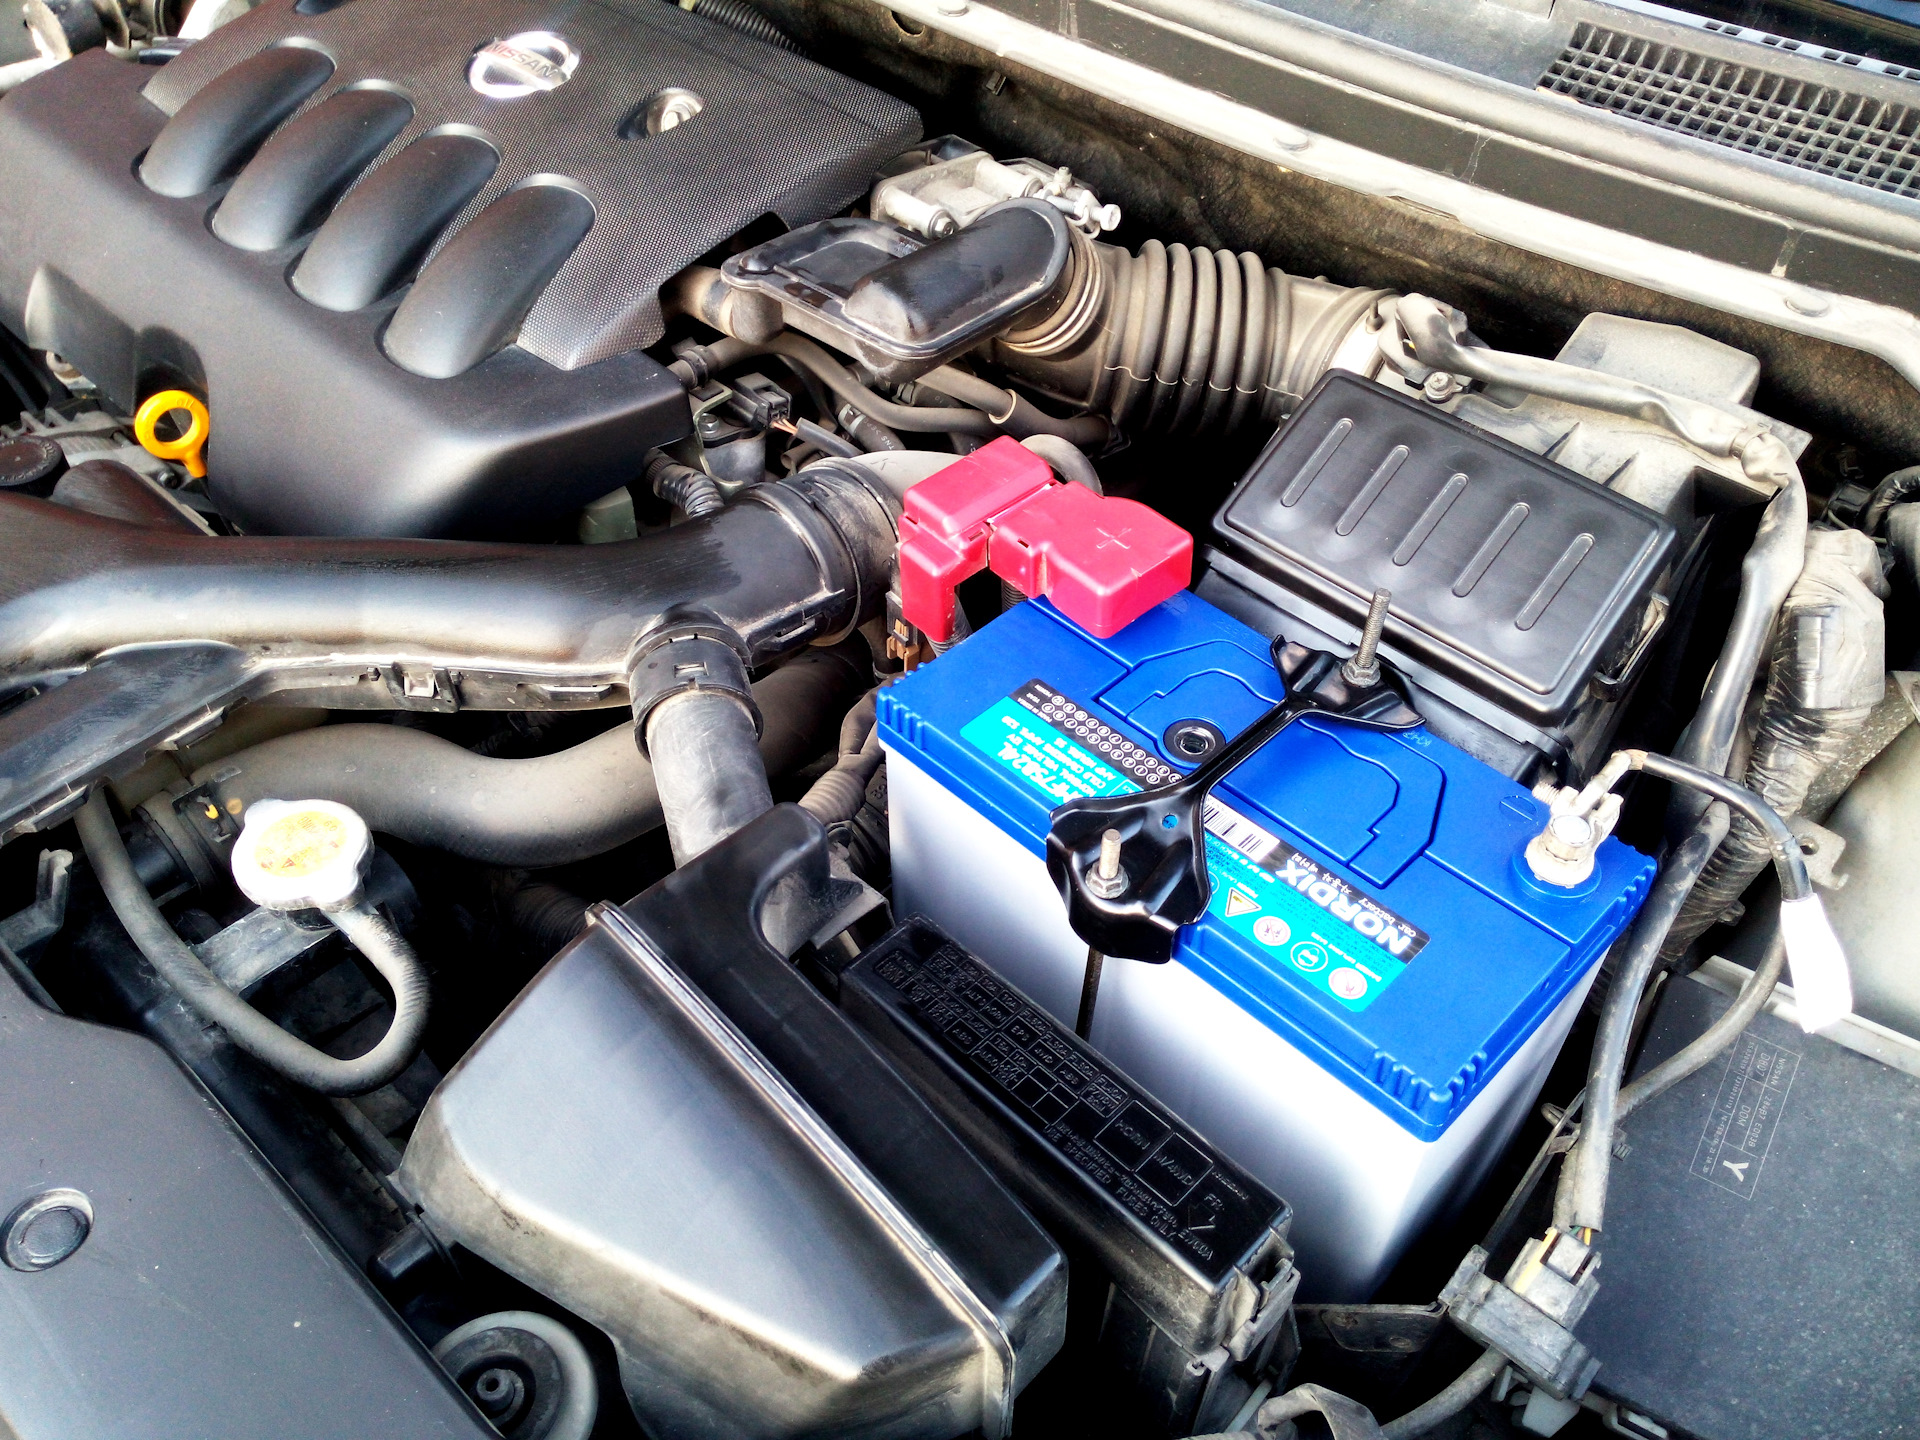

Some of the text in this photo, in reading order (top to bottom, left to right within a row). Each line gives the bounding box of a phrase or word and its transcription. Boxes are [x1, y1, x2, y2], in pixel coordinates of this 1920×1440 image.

[485, 43, 559, 78] NISSAN
[998, 742, 1081, 802] MF75B24L
[1278, 861, 1409, 952] NORDIX
[1358, 897, 1416, 937] car battery
[1770, 1057, 1786, 1085] NISSAN
[1114, 1119, 1150, 1150] HORN
[1067, 1142, 1111, 1183] SPECIFIED
[1116, 1186, 1148, 1216] FUSES
[1722, 1160, 1749, 1181] Y
